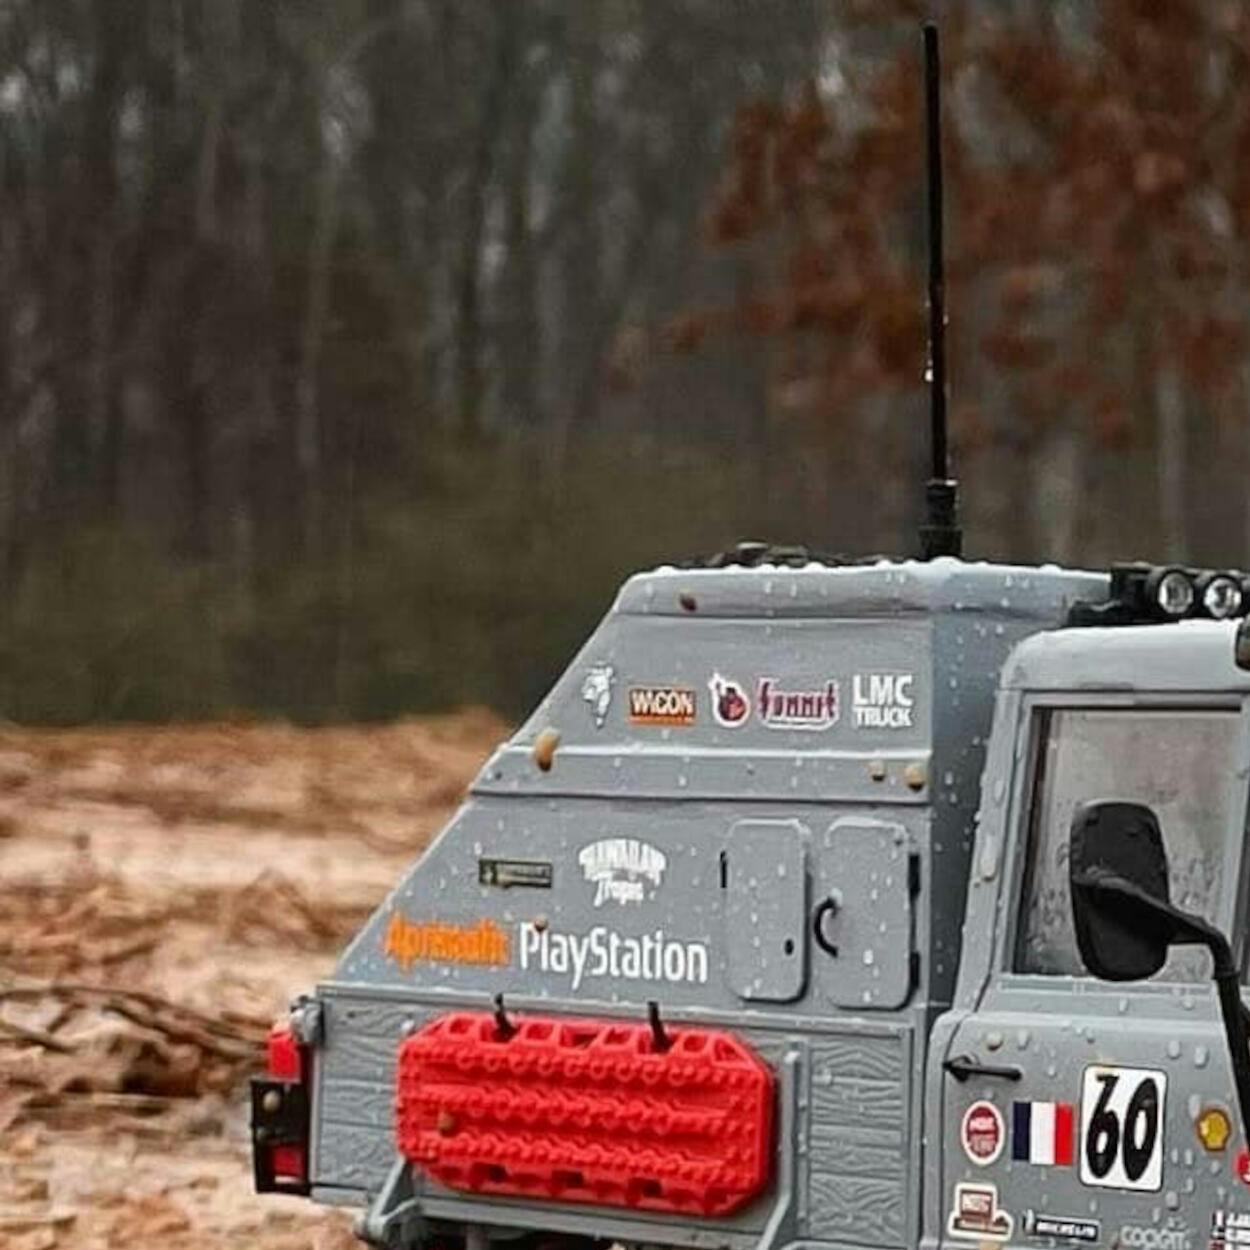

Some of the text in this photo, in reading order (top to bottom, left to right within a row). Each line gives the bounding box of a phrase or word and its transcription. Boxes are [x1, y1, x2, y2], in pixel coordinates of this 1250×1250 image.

[853, 674, 913, 706] LMC
[853, 706, 913, 727] TRUCK
[519, 922, 708, 990] PlayStation
[1086, 1073, 1159, 1182] 60
